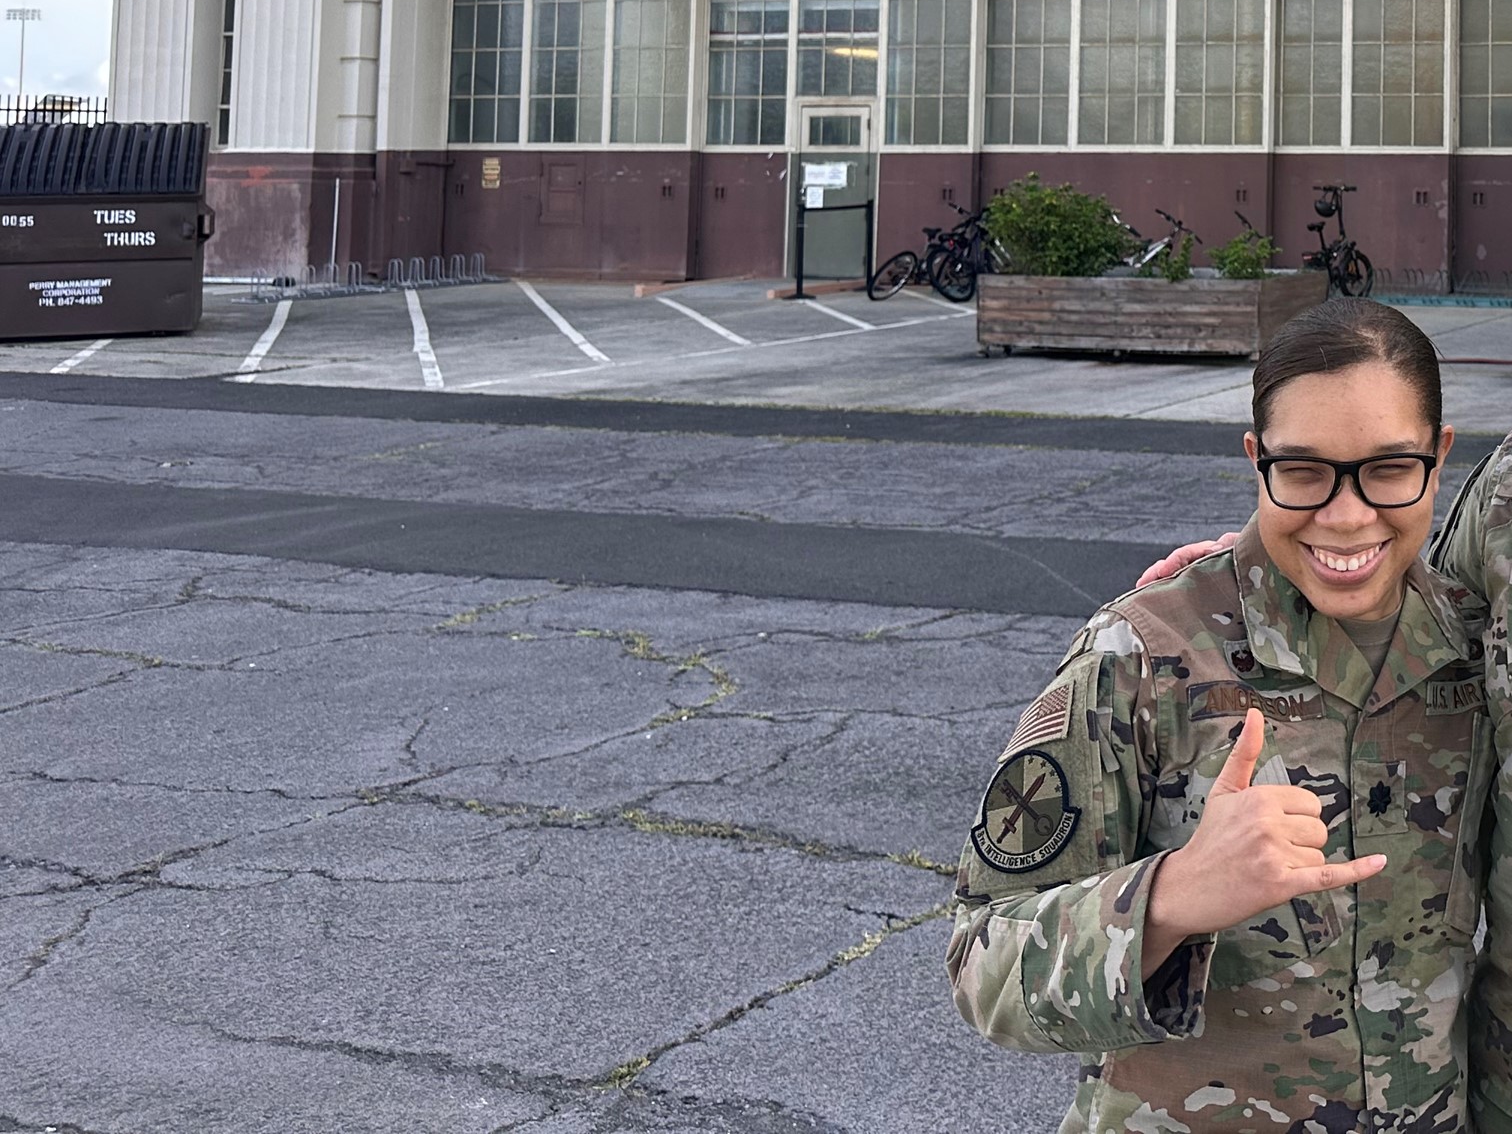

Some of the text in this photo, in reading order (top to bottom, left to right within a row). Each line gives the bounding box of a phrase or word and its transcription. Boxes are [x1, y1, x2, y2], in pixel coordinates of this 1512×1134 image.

[2, 215, 34, 227] 0055
[93, 209, 136, 225] TUES
[104, 231, 156, 247] THURS
[29, 278, 112, 290] PERRY MANAGEMENT
[42, 287, 100, 297] CORPORATION
[1453, 682, 1481, 708] AIR
[984, 843, 1038, 867] INTELLIGENCE
[1040, 813, 1074, 859] SQUADRON
